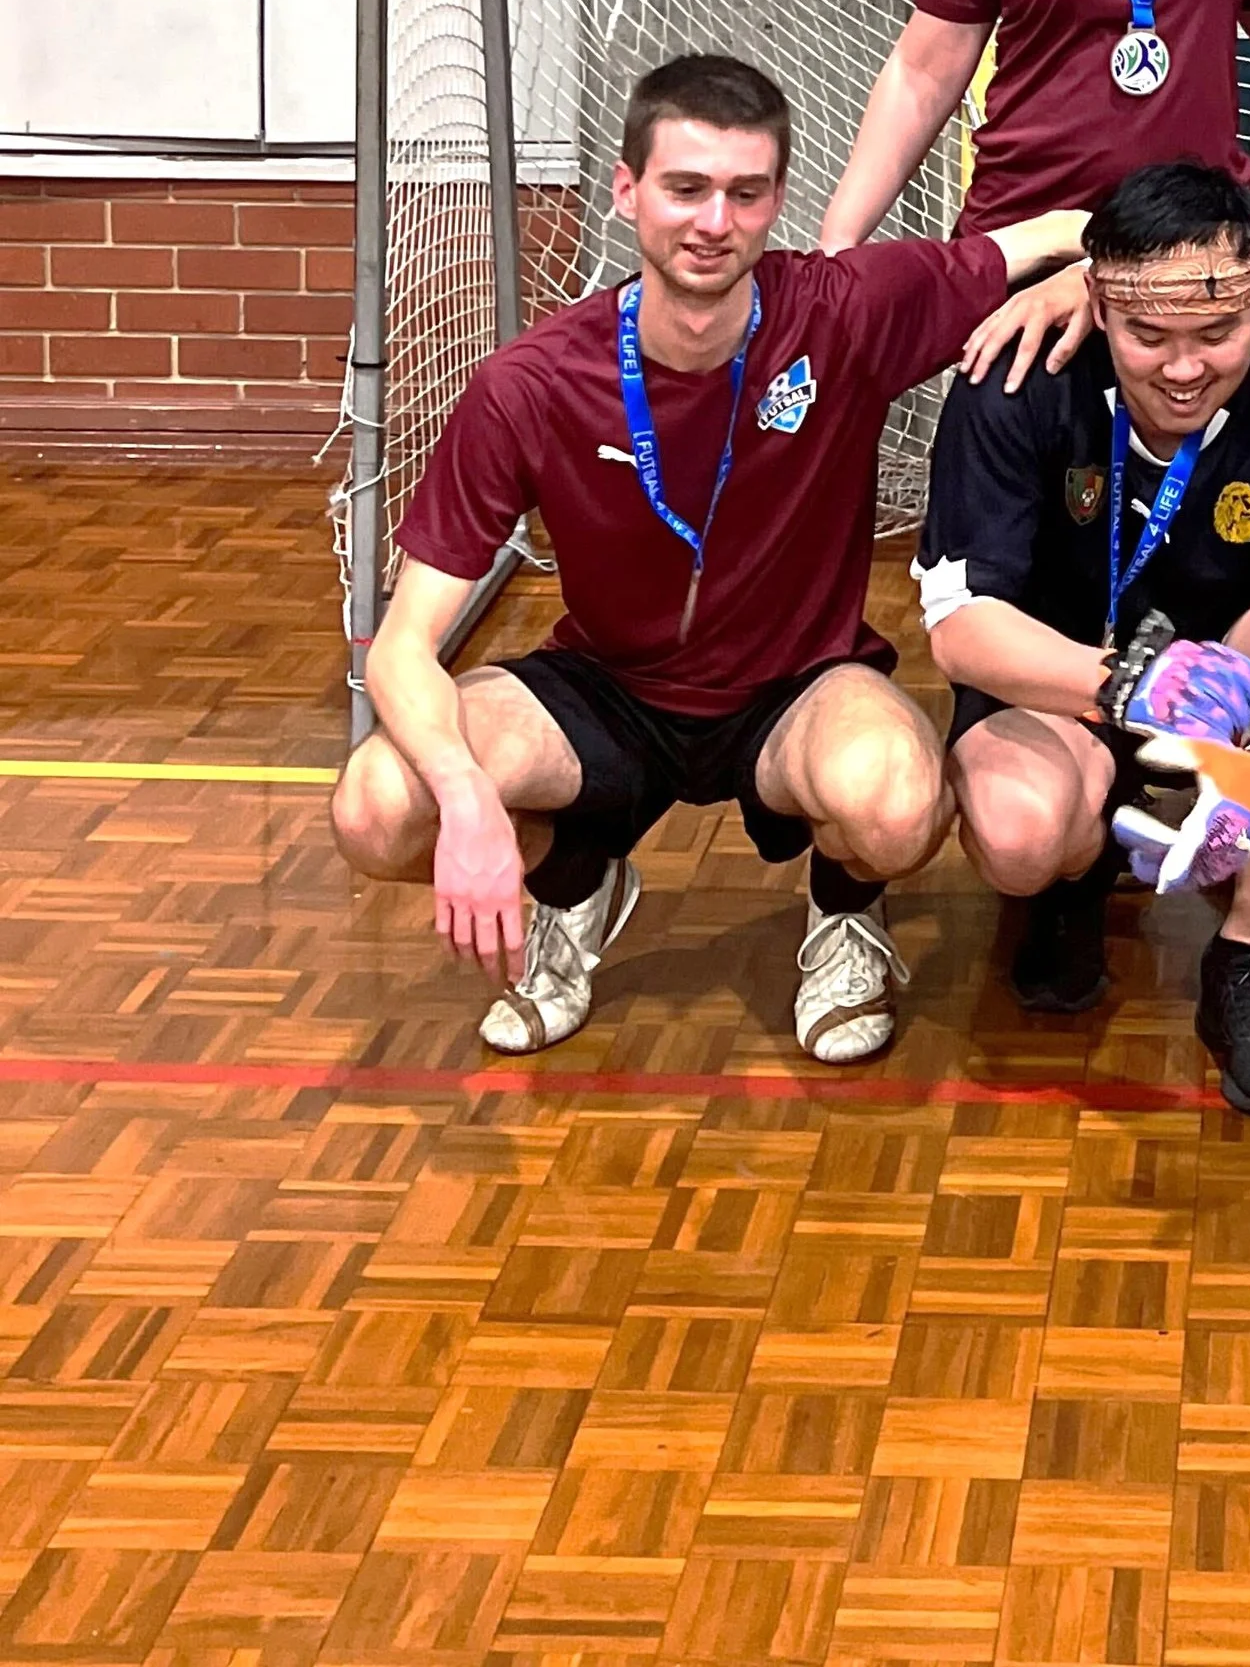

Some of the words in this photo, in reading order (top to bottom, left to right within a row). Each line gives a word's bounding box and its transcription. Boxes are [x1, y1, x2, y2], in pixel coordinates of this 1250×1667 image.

[624, 316, 636, 328] 4
[761, 387, 810, 424] FUTSAL
[1149, 522, 1163, 537] 4
